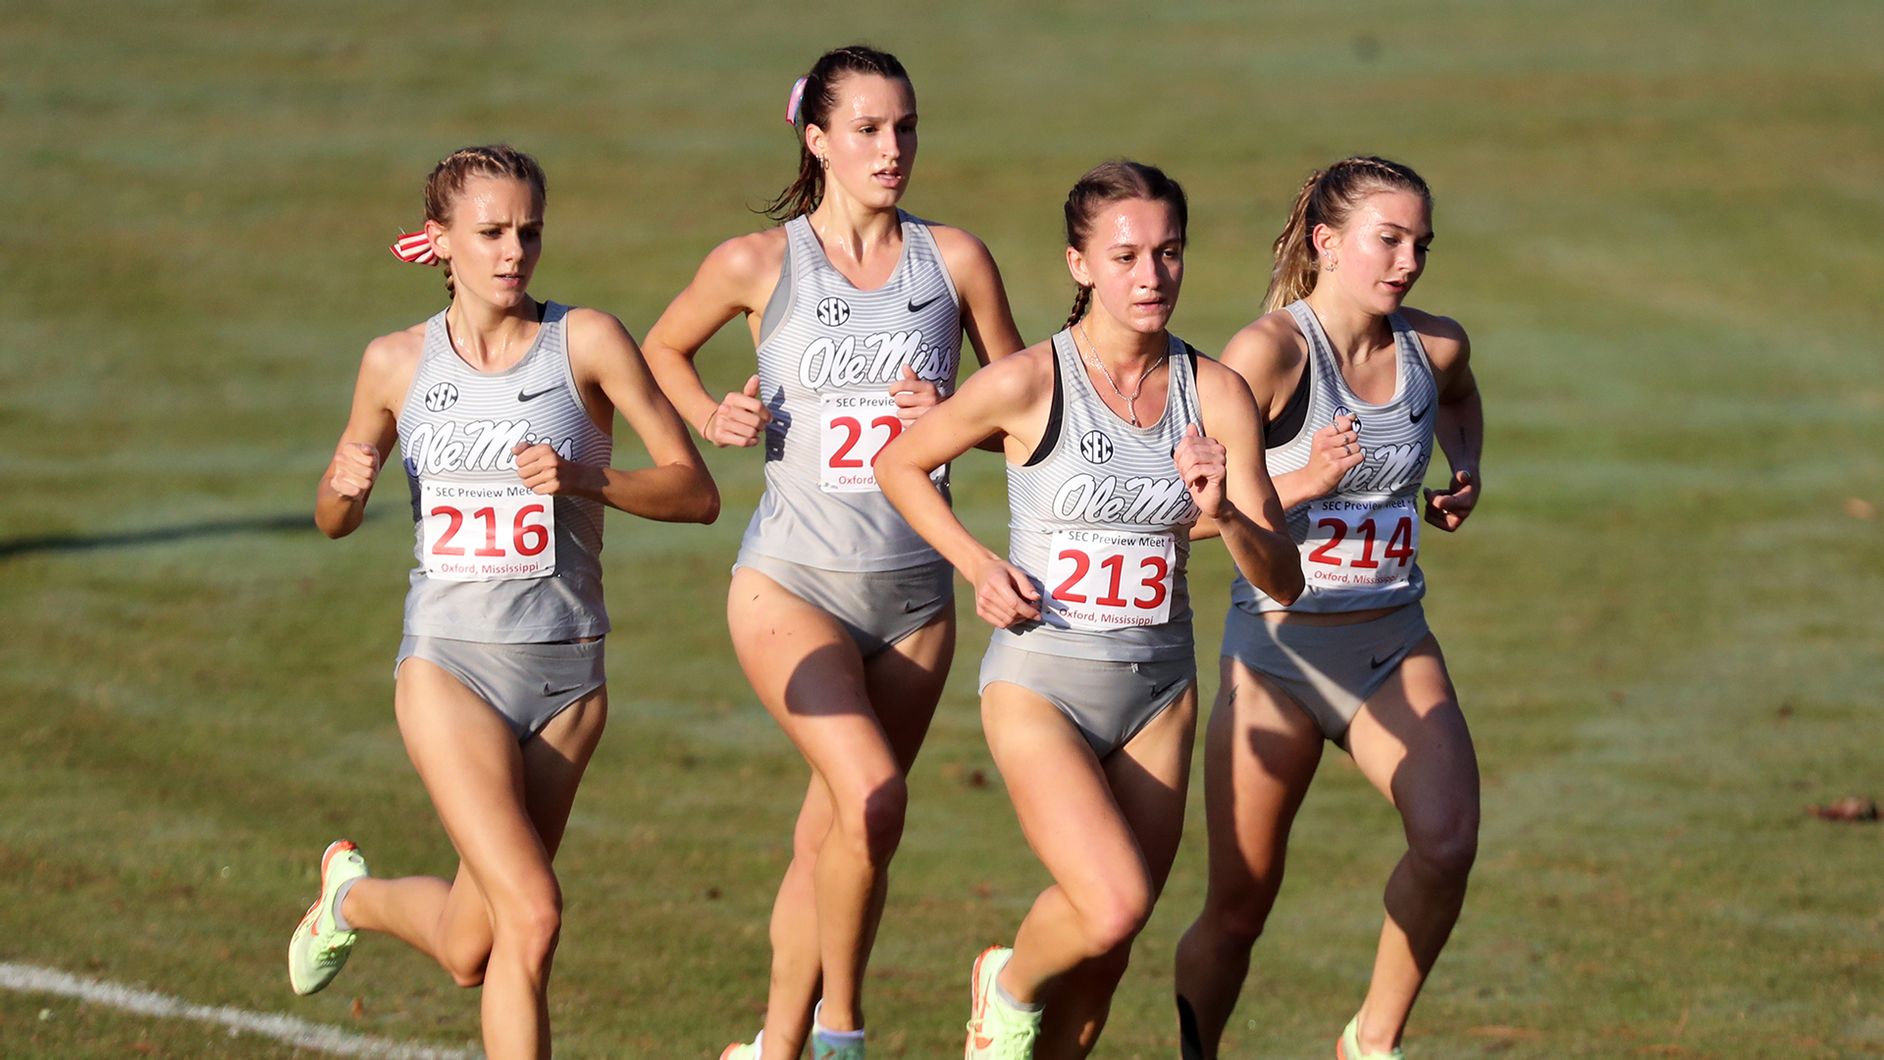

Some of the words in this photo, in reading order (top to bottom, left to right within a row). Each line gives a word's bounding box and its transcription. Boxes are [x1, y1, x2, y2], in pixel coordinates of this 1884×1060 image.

[817, 297, 850, 327] SEC
[799, 335, 866, 391] Ole
[864, 329, 953, 385] Miss
[426, 382, 459, 412] SEC
[836, 397, 856, 408] SEC
[860, 396, 895, 408] Previe
[406, 420, 465, 478] Ole
[828, 415, 903, 468] 22
[1080, 430, 1114, 464] SEC
[1336, 446, 1374, 494] le
[436, 487, 456, 497] SEC
[458, 488, 503, 498] Preview
[507, 486, 532, 497] Mee
[1052, 473, 1126, 524] Ole
[1124, 475, 1201, 526] Mis
[1322, 501, 1341, 511] SEC
[431, 504, 549, 556] 216
[1068, 530, 1089, 542] SEC
[1092, 533, 1136, 547] Preview
[1138, 537, 1165, 547] Meet
[1308, 516, 1414, 569] 214
[441, 564, 479, 575] Oxford,
[482, 561, 539, 574] Mississippi
[1051, 549, 1168, 609] 213
[1314, 570, 1350, 584] Oxford,
[1059, 607, 1098, 622] Oxford,
[1101, 613, 1154, 626] Mississippi
